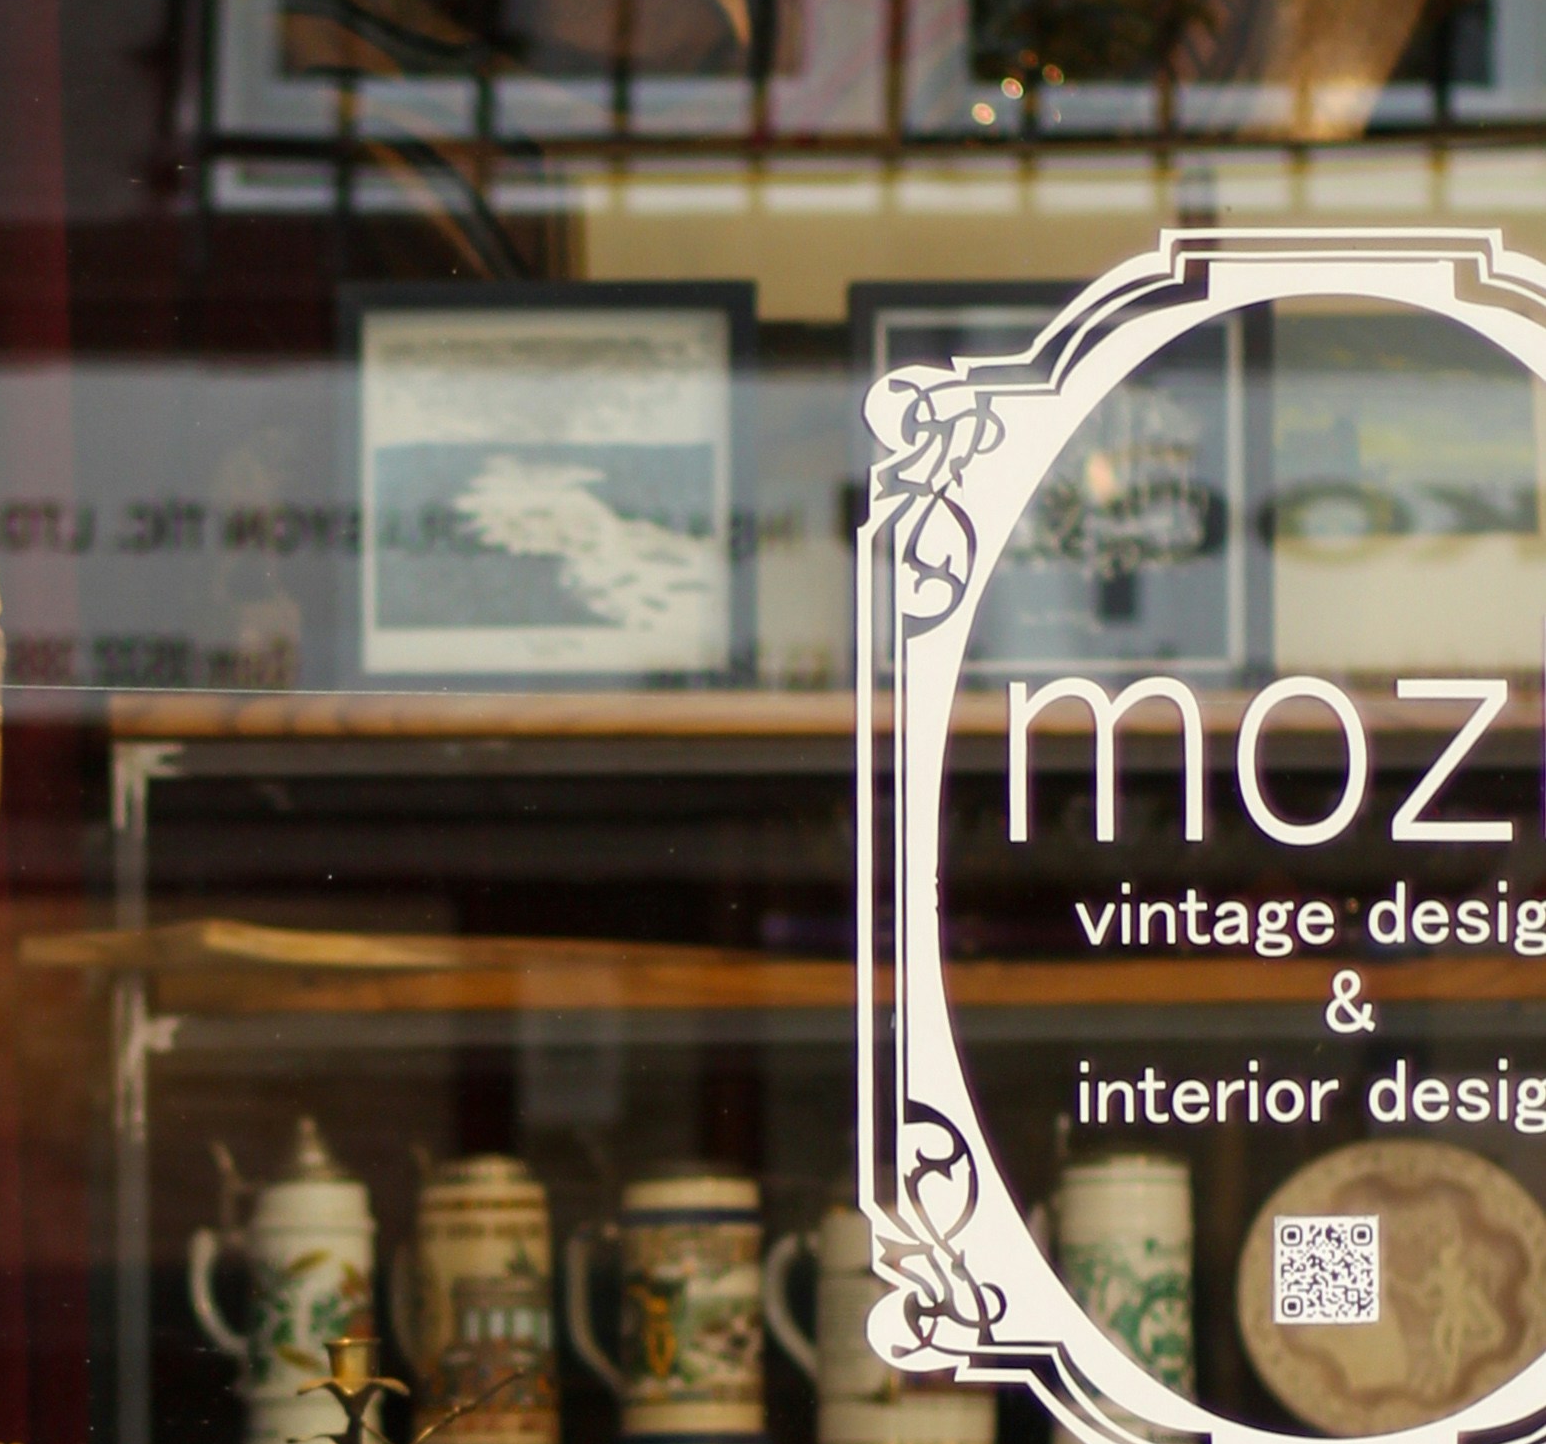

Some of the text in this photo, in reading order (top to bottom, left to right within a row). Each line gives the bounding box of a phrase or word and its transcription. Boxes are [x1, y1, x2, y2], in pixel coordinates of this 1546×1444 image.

[1075, 880, 1546, 957] vintage desig
[1325, 969, 1376, 1034] &
[1079, 1058, 1546, 1134] interior desig
